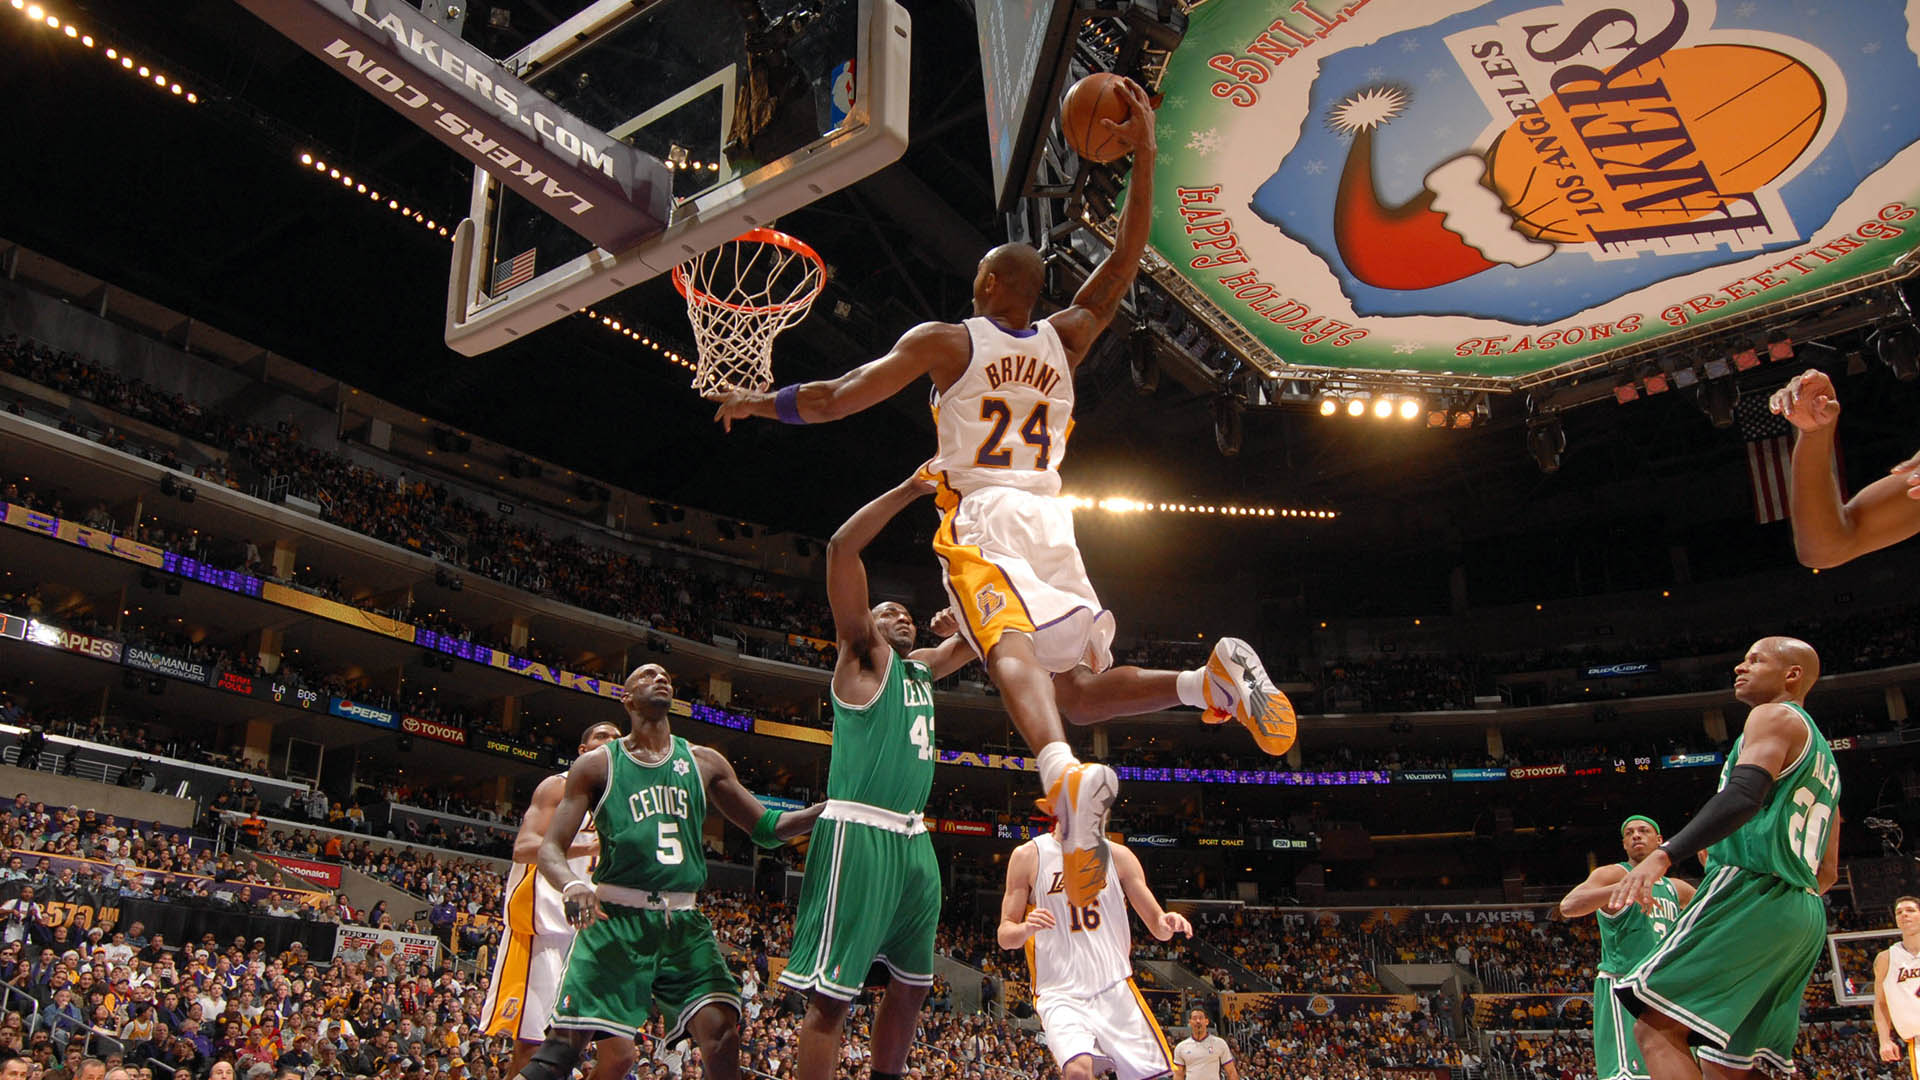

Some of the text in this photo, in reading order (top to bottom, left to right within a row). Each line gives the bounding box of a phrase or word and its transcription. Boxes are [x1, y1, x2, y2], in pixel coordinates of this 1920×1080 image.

[351, 0, 615, 178] LAKERS.COM
[323, 38, 594, 216] LAKERS.COM
[1471, 40, 1604, 216] LOS ANGELES
[1522, 0, 1774, 253] LAKERS
[1176, 185, 1369, 346] HAPPY HOLIDAYS
[1454, 201, 1917, 359] SEASONS GREETINGS
[985, 355, 1061, 397] BRYANT
[974, 396, 1052, 471] 24
[128, 648, 205, 676] SAN MANUEL
[272, 683, 317, 702] LA BOS
[274, 693, 310, 709] 0 0
[352, 705, 392, 723] PEPSI
[421, 722, 465, 742] TOYOTA
[487, 740, 538, 760] SPORT CHALET
[1613, 757, 1650, 767] LA BOS
[1679, 755, 1715, 764] PEPSI
[1526, 766, 1566, 776] TOYOTA
[628, 785, 689, 823] CELTICS
[656, 821, 684, 865] 5
[1150, 836, 1178, 844] LIGHT
[1198, 838, 1218, 846] SPORT
